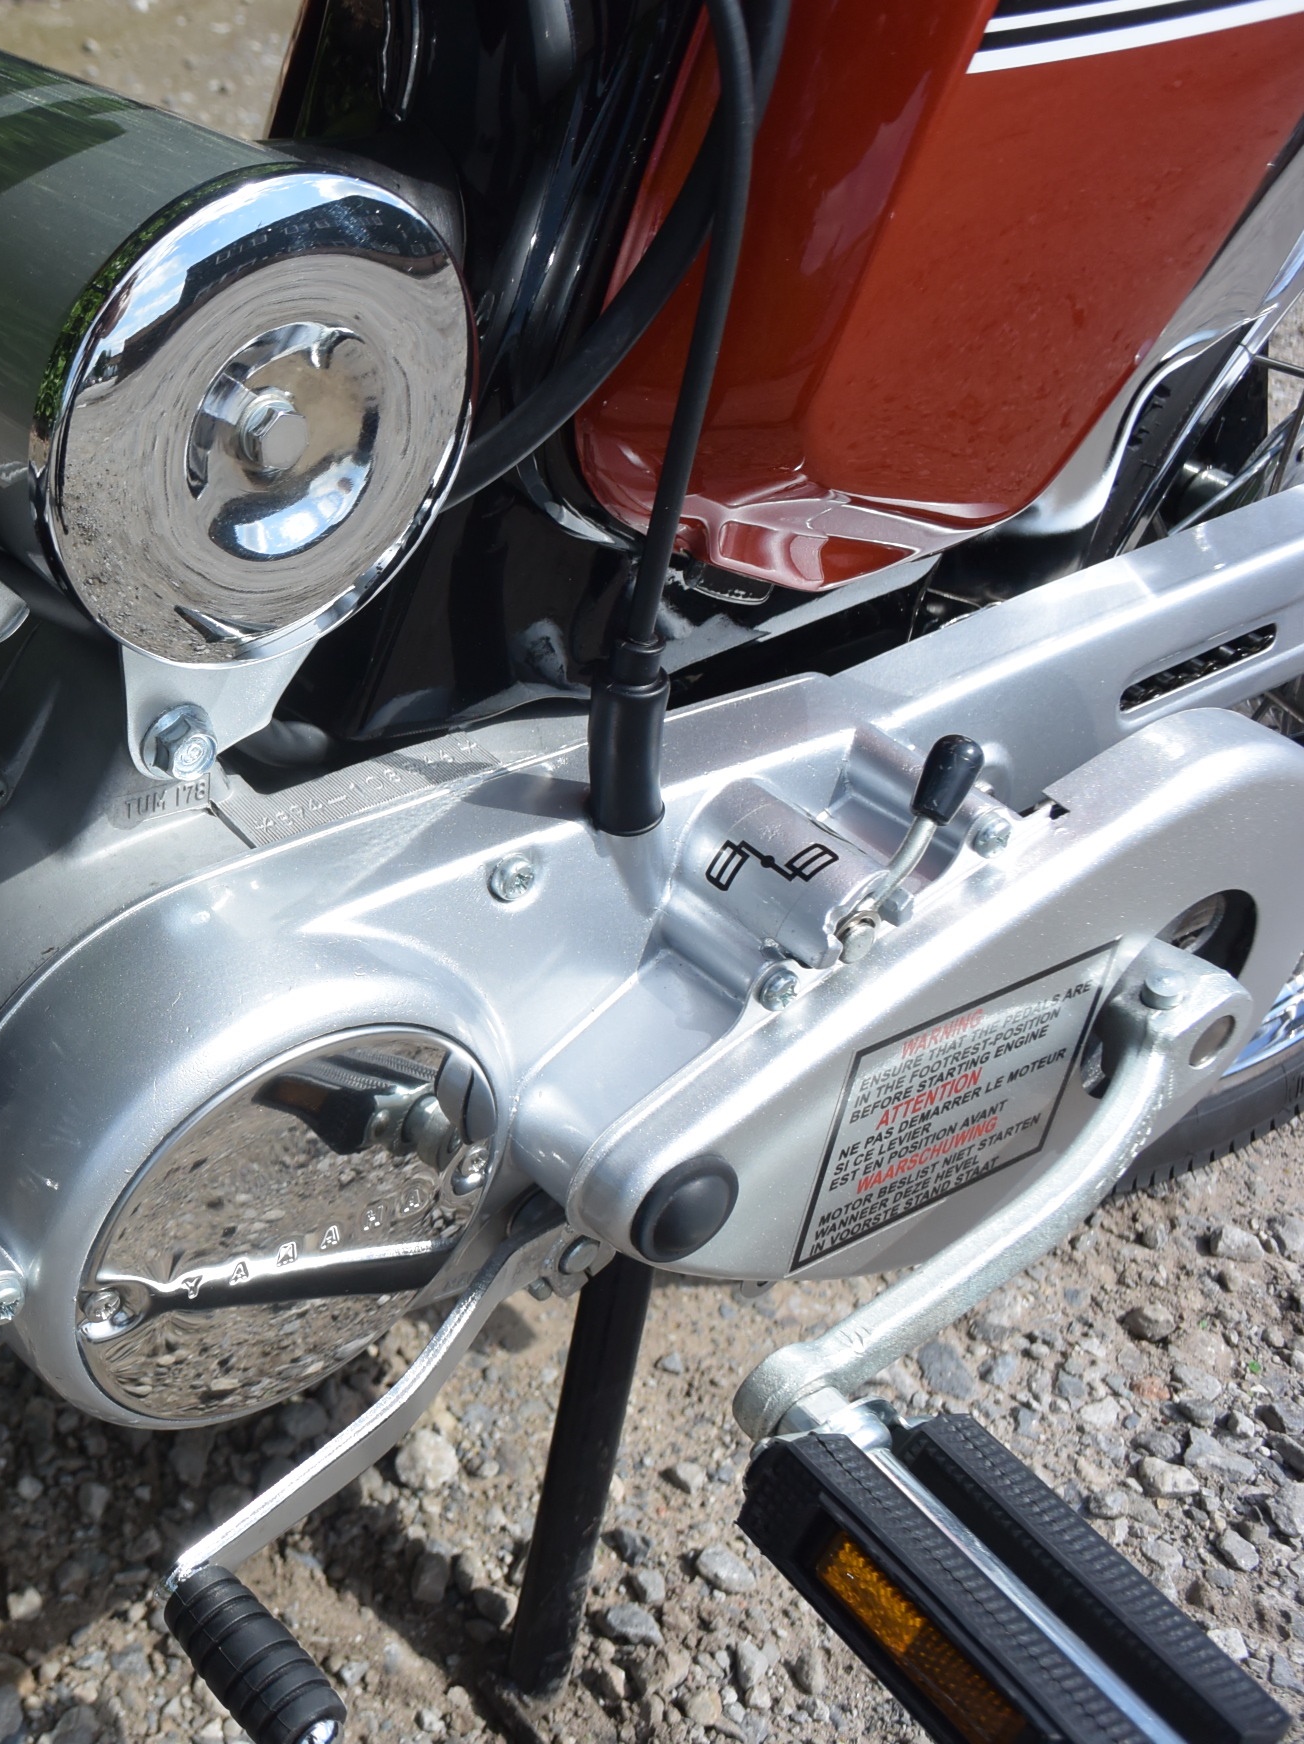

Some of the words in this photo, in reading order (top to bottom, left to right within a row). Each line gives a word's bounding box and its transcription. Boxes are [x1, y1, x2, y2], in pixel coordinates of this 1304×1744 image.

[849, 1085, 913, 1124] BEFORE
[917, 1051, 991, 1094] STARTING
[994, 1024, 1049, 1059] ENGINE
[854, 1091, 871, 1108] IN
[876, 1075, 906, 1099] THE
[909, 1007, 1062, 1083] FOOTREST-POSITION
[859, 1053, 924, 1092] ENSURE
[929, 1034, 966, 1061] THAT
[971, 1020, 998, 1042] THE
[1003, 994, 1060, 1028] PEDALS
[1062, 979, 1093, 1002] ARE
[901, 1008, 984, 1060] WARNING
[829, 1169, 857, 1192] EST
[862, 1156, 884, 1176] EN
[888, 1121, 959, 1168] POSITION
[959, 1099, 1008, 1130] AVANT
[838, 1142, 861, 1162] NE
[864, 1127, 894, 1149] PAS
[898, 1086, 982, 1133] DEMARRER
[984, 1076, 1005, 1095] LE
[1006, 1048, 1067, 1085] MOTEUR
[875, 1066, 982, 1131] ATTENTION
[818, 1192, 874, 1227] MOTOR
[877, 1161, 940, 1199] BESLIST
[942, 1145, 973, 1169] NIET
[977, 1112, 1042, 1152] STARTEN
[833, 1161, 850, 1177] SI
[853, 1150, 875, 1168] CE
[878, 1122, 932, 1158] LEVIER
[856, 1115, 999, 1195] WAARSCHUWING
[809, 1240, 825, 1257] IN
[830, 1206, 900, 1247] VOORSTE
[903, 1178, 951, 1211] STAND
[954, 1156, 1000, 1187] STAAT
[814, 1198, 888, 1241] WANNEER
[893, 1180, 932, 1205] DEZE
[934, 1156, 980, 1185] HEVEL
